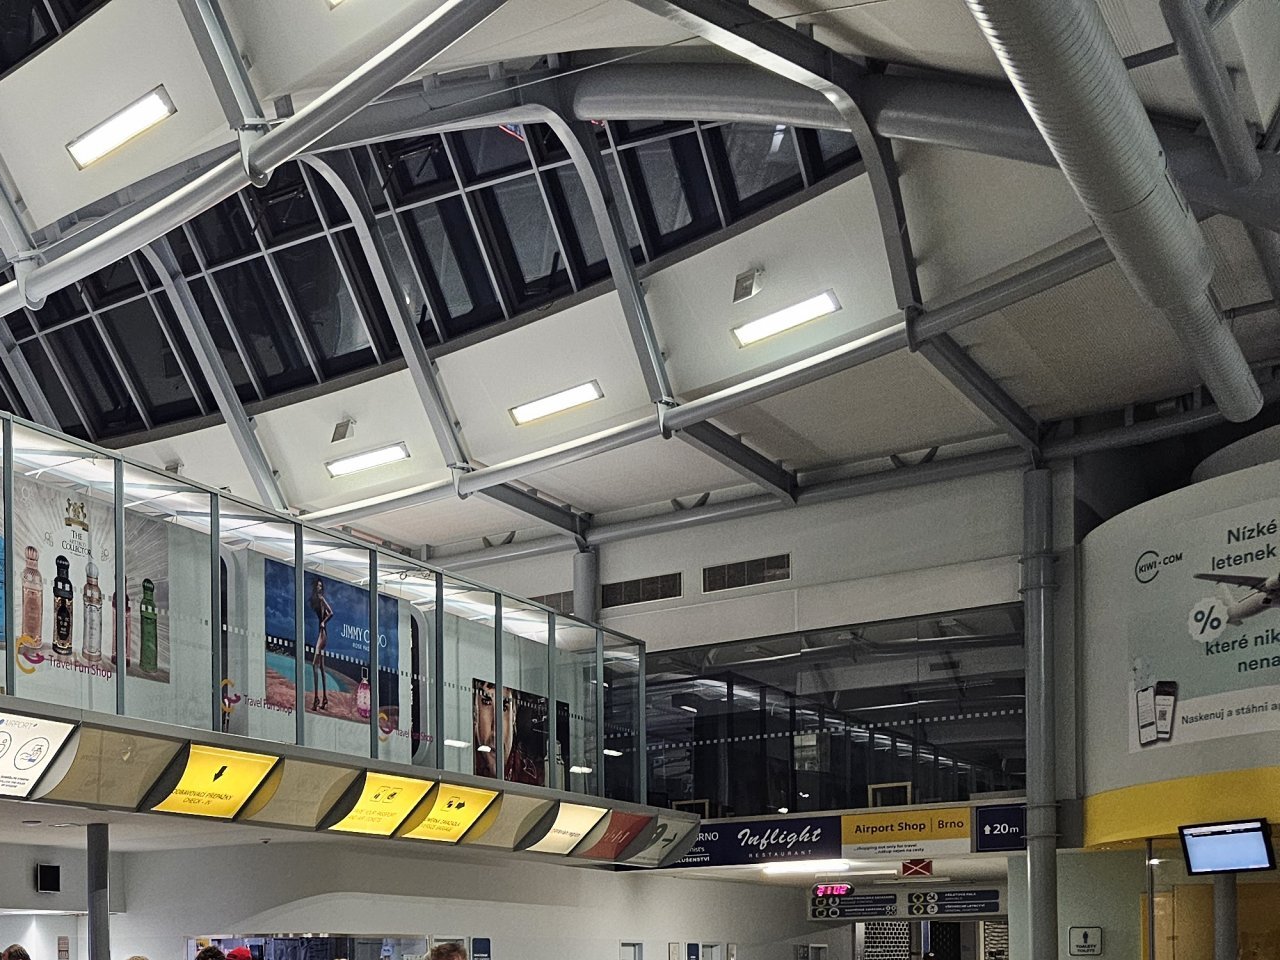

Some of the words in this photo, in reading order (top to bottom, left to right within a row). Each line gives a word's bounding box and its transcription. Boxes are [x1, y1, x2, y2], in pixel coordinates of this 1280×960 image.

[71, 530, 83, 540] THE
[1227, 518, 1278, 544] Nízké
[62, 540, 94, 559] COLLECTOR
[1211, 543, 1277, 571] letenek
[1193, 605, 1221, 635] %
[341, 624, 363, 641] JIMMY
[363, 629, 387, 648] CO
[1205, 636, 1249, 656] které
[1254, 629, 1280, 649] nik
[48, 655, 74, 671] Travel
[74, 661, 90, 675] Fun
[91, 664, 112, 681] Shop
[1237, 655, 1280, 673] nena
[243, 695, 262, 707] Travel
[5, 719, 33, 729] AIRPORT
[1181, 709, 1225, 725] Naskenuj
[1227, 709, 1233, 717] a
[1271, 702, 1280, 713] a
[855, 823, 894, 835] Airport
[897, 822, 926, 832] Shop
[938, 818, 964, 829] Brno
[737, 825, 822, 850] Inflight
[749, 849, 812, 858] RESTAURANT
